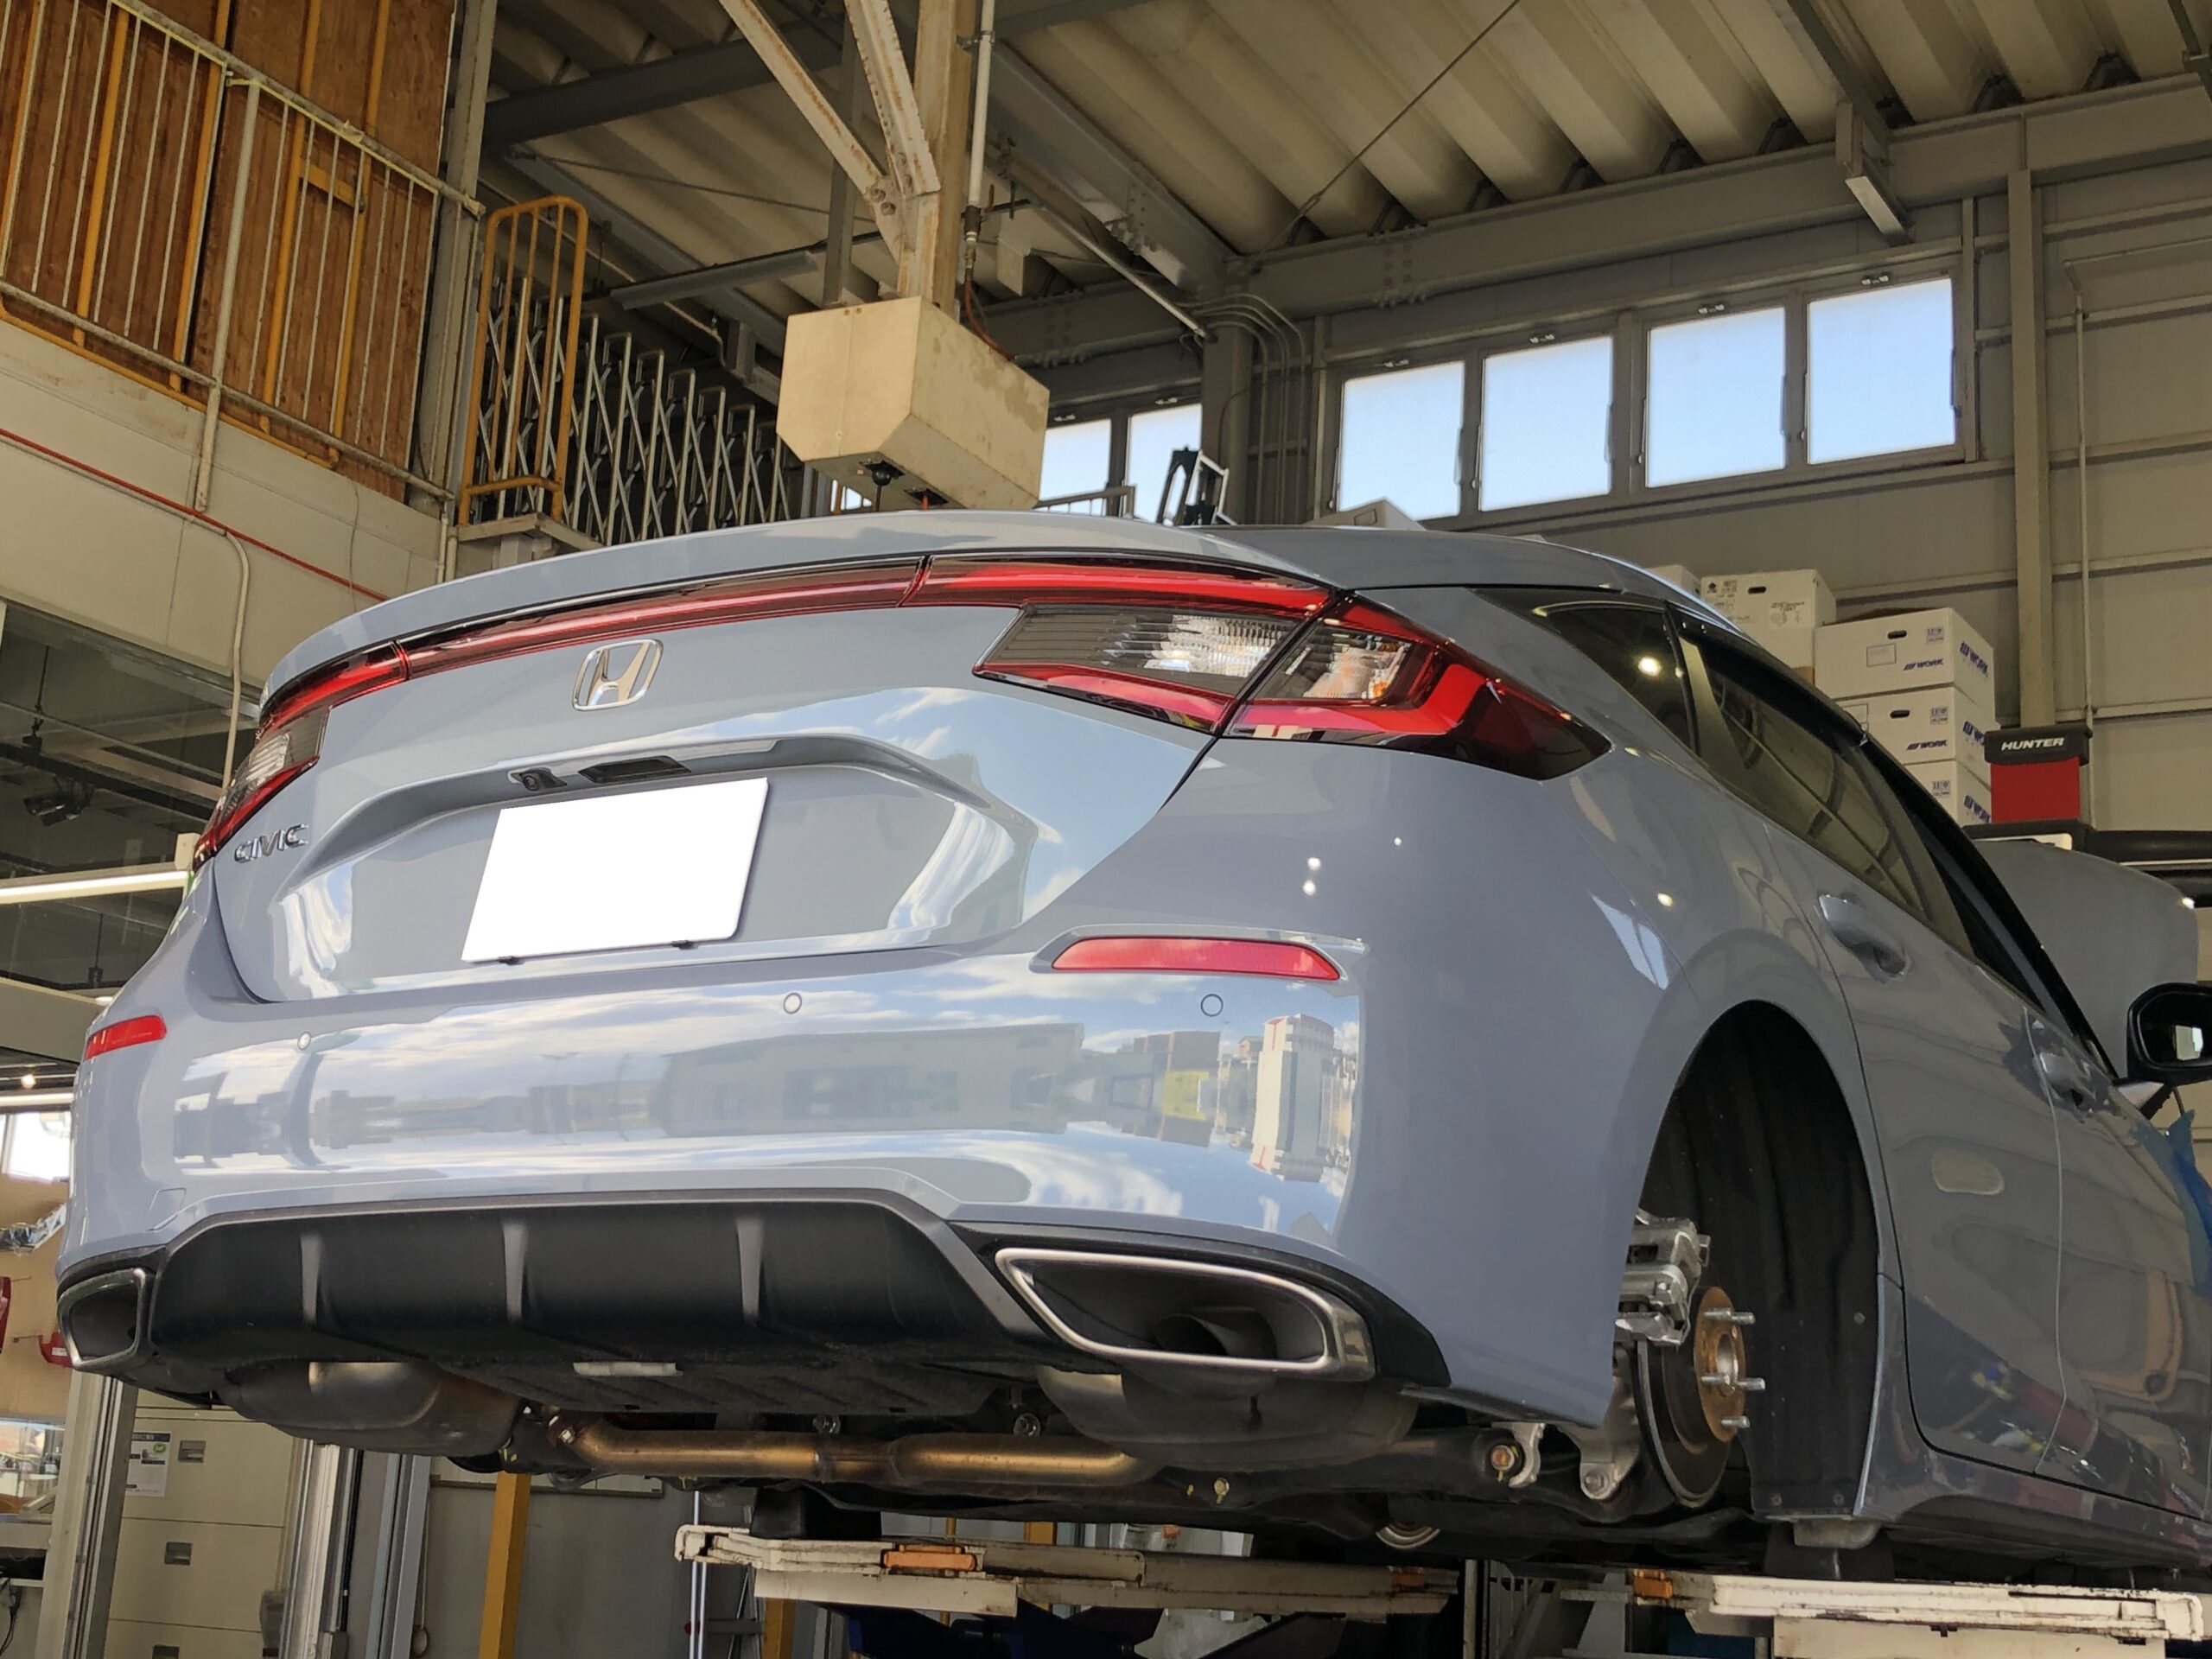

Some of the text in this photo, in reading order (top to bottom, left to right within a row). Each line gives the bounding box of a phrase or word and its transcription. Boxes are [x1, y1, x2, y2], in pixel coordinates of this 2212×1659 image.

[1916, 658, 1944, 669] WORK
[1920, 739, 1948, 749] WORK
[2000, 737, 2065, 752] HUNTER
[234, 823, 309, 864] CIVIC
